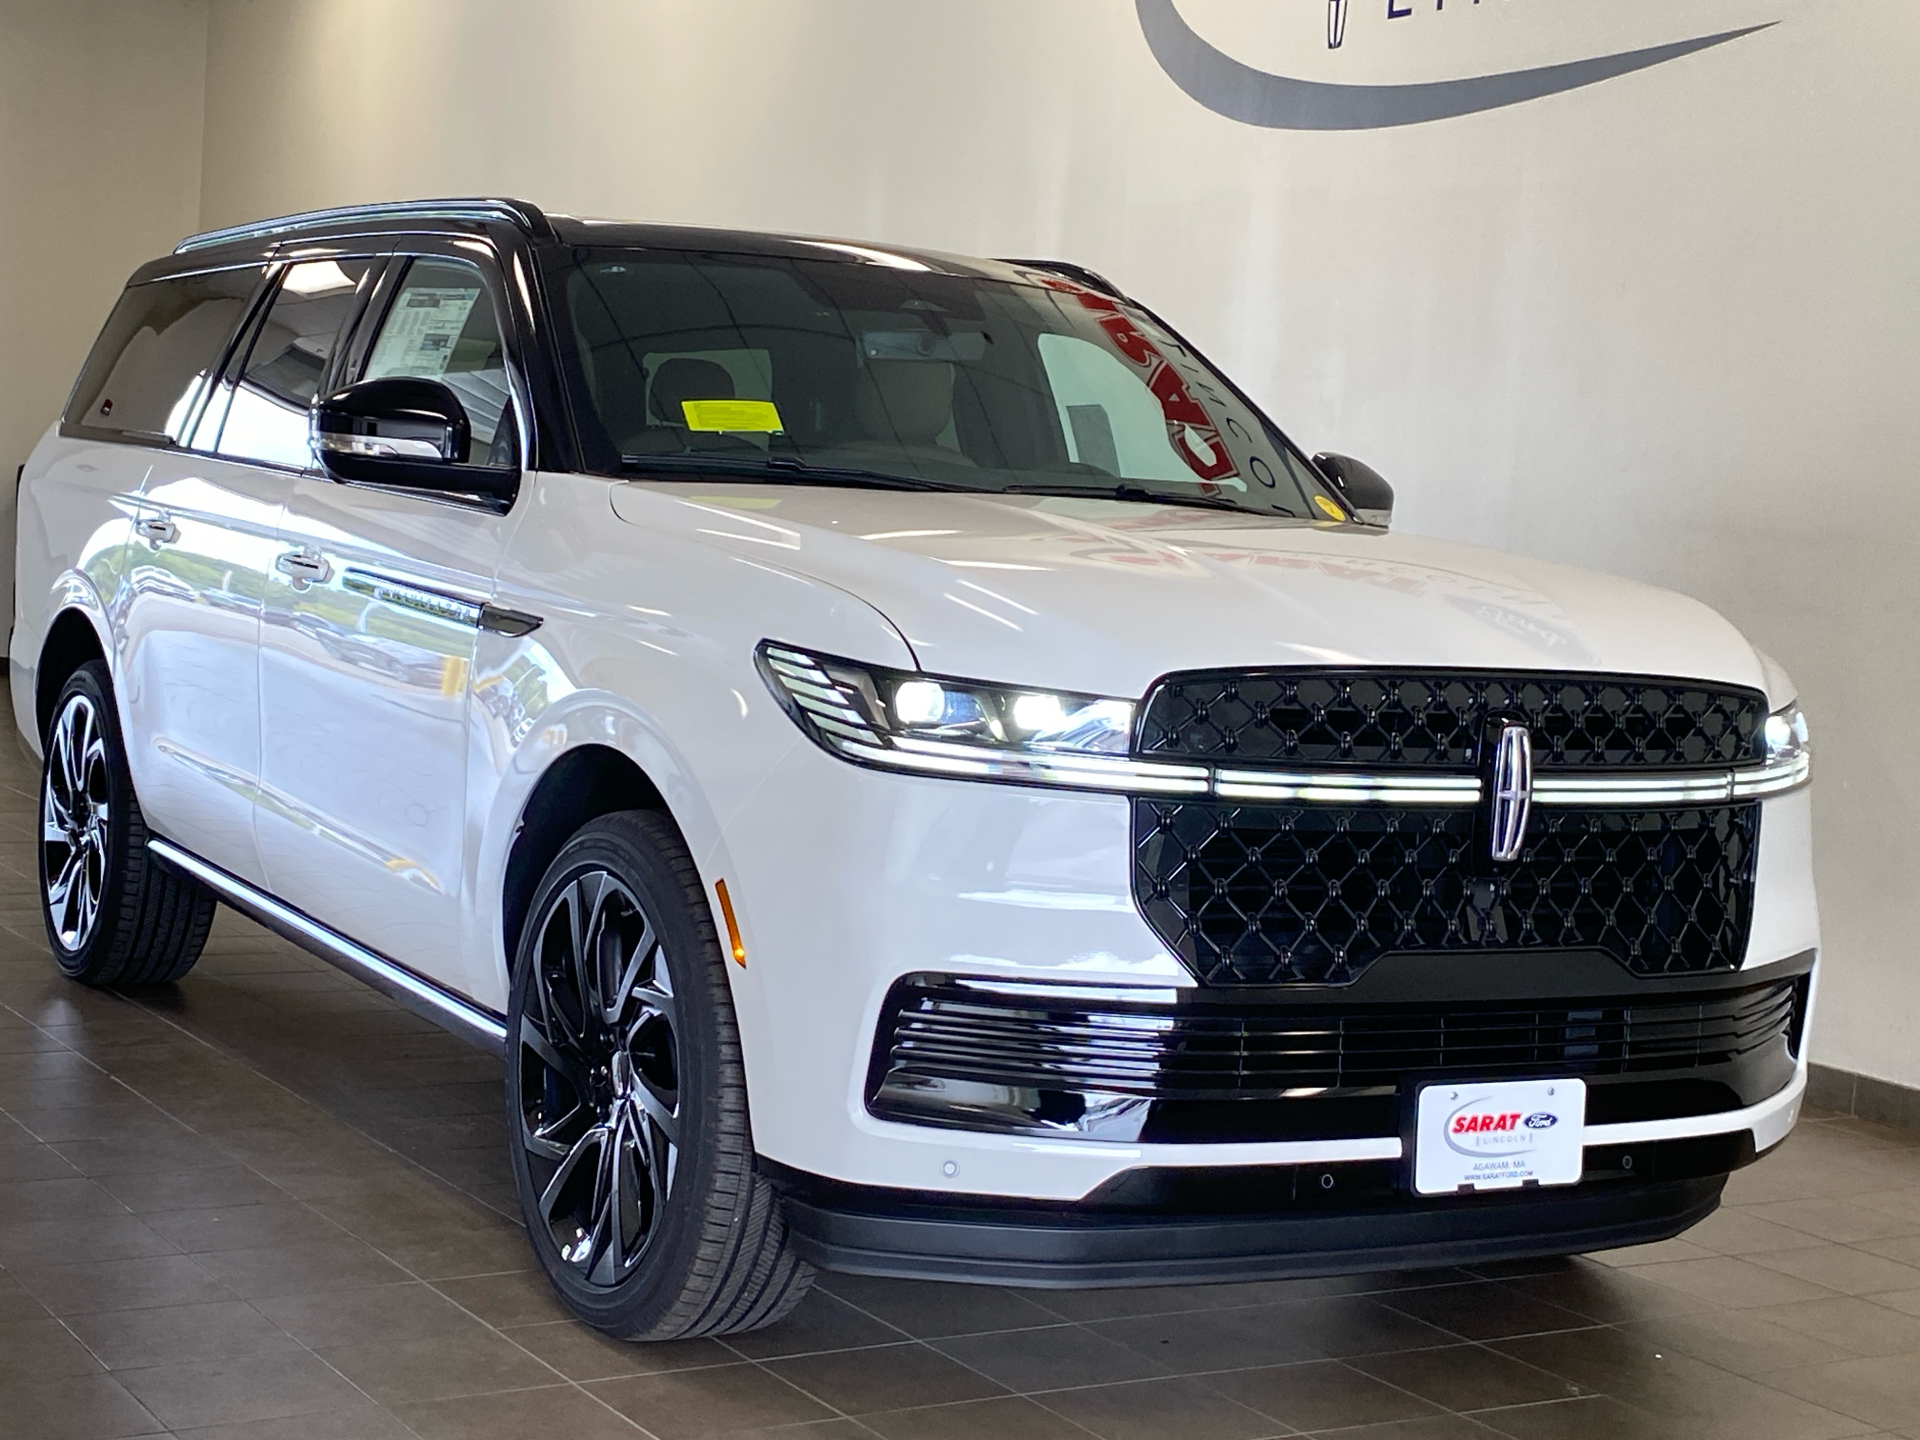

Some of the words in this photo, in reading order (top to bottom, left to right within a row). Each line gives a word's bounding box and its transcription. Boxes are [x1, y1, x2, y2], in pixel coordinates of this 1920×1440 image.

[1452, 1113, 1521, 1134] SARAT
[1528, 1114, 1552, 1128] Ford
[1483, 1135, 1525, 1144] LINCOLN
[1513, 1160, 1526, 1168] MA
